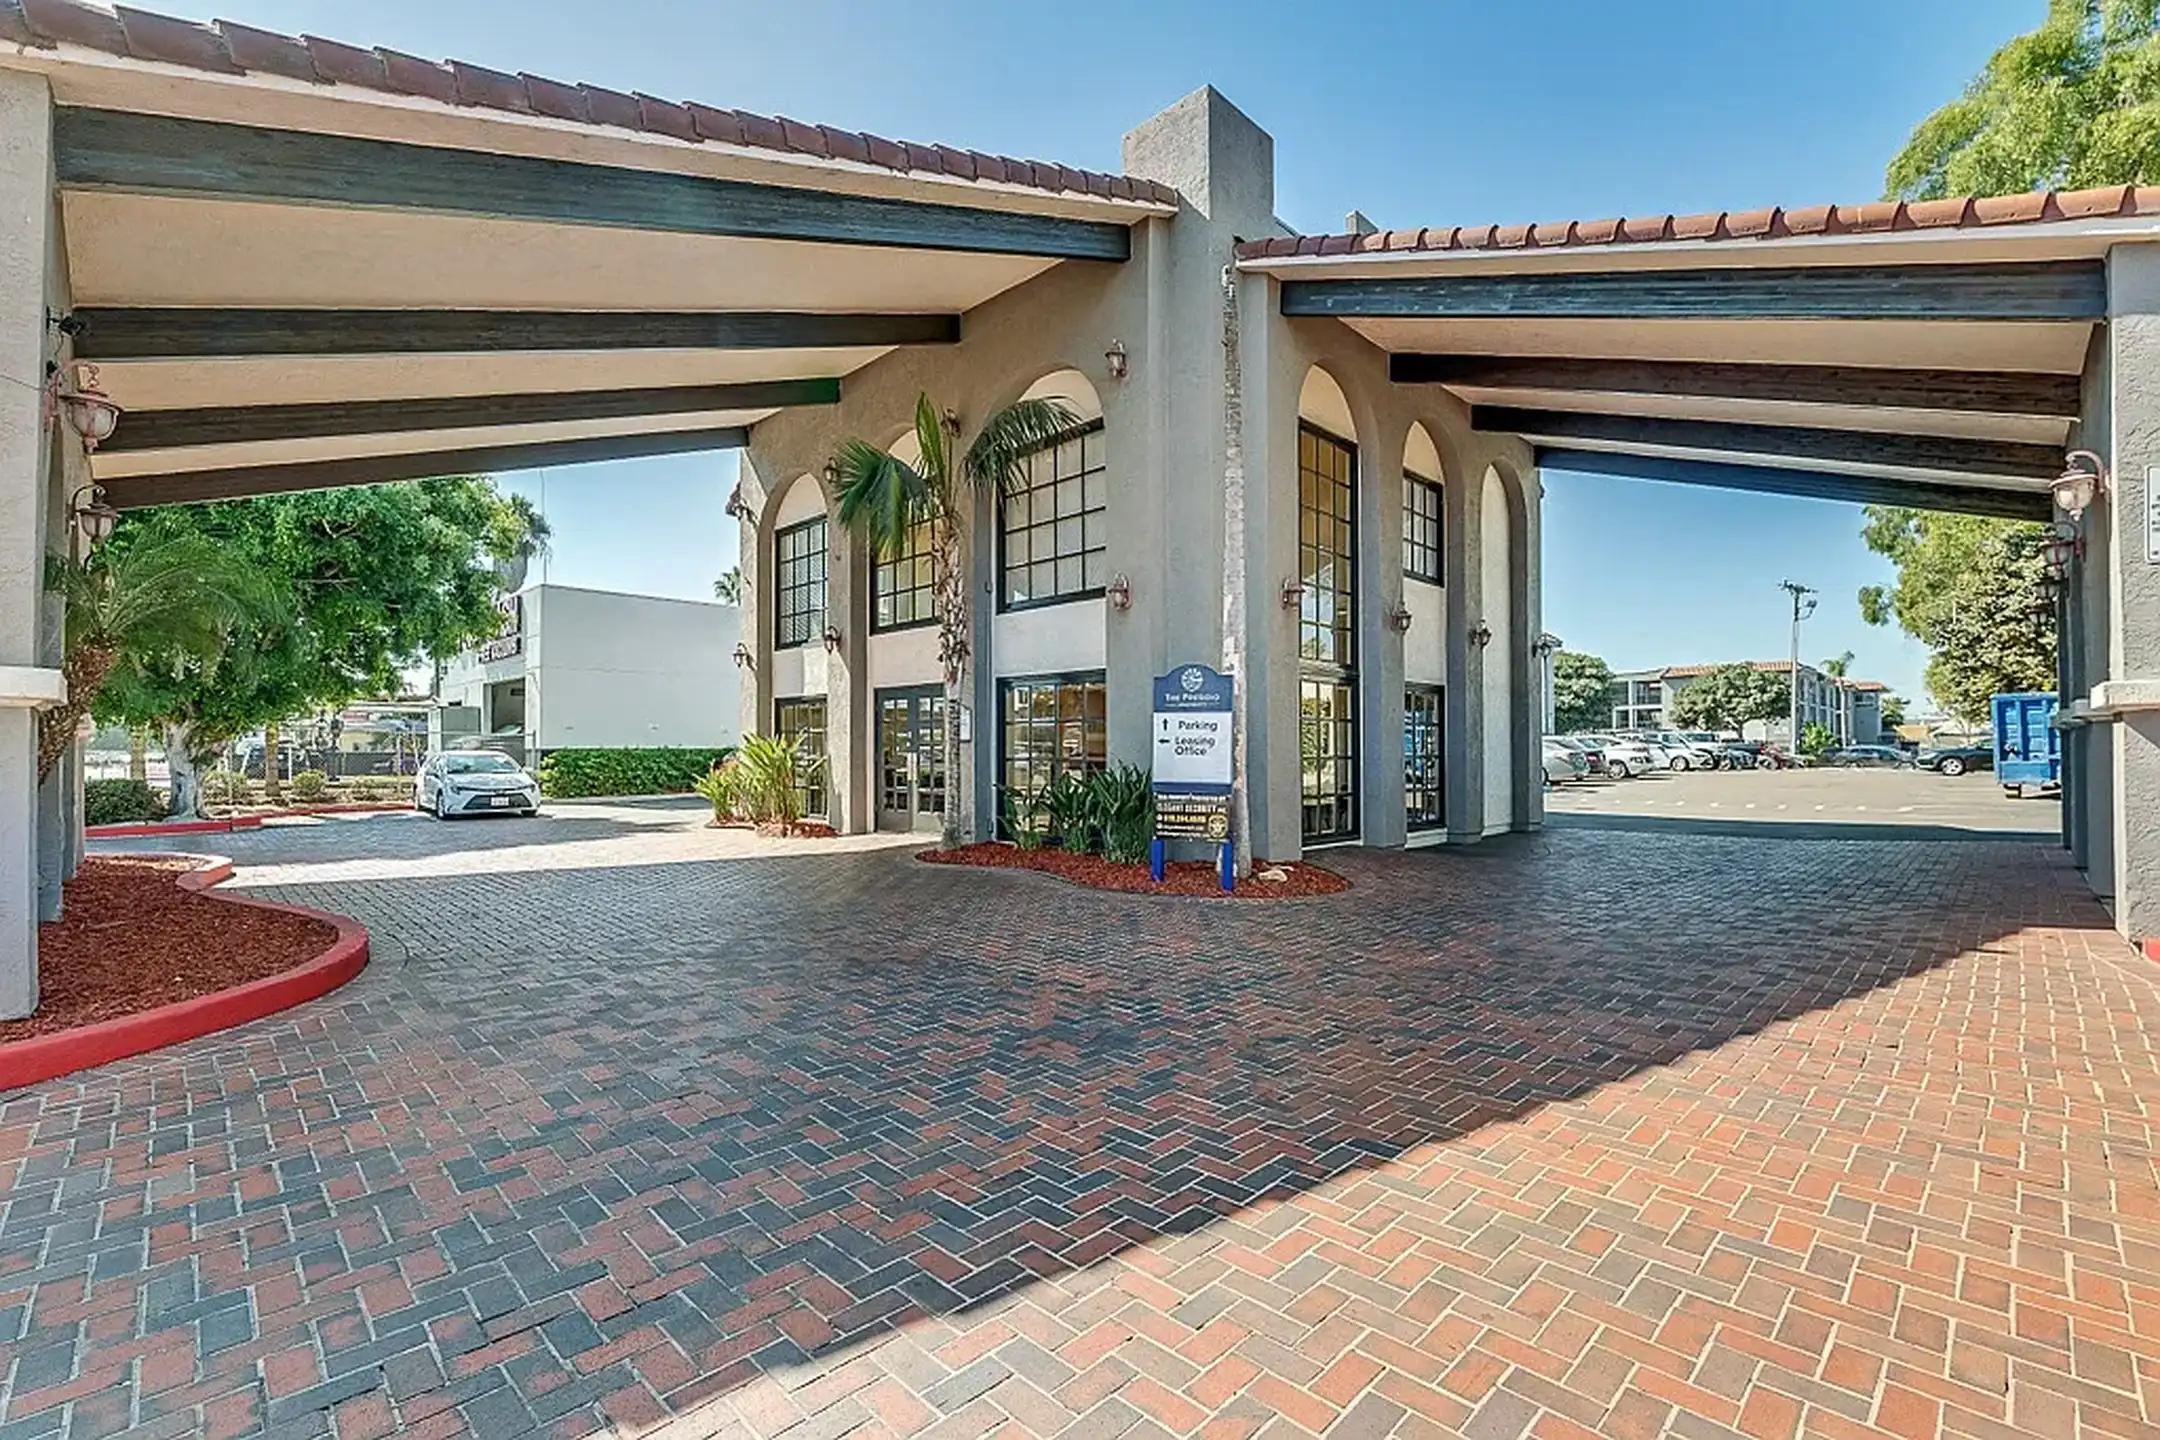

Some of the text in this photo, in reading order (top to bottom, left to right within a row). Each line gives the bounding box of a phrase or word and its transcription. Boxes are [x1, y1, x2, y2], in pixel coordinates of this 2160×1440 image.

[1178, 720, 1218, 732] Parking
[1174, 736, 1216, 749] Leasing
[1174, 746, 1207, 756] Office
